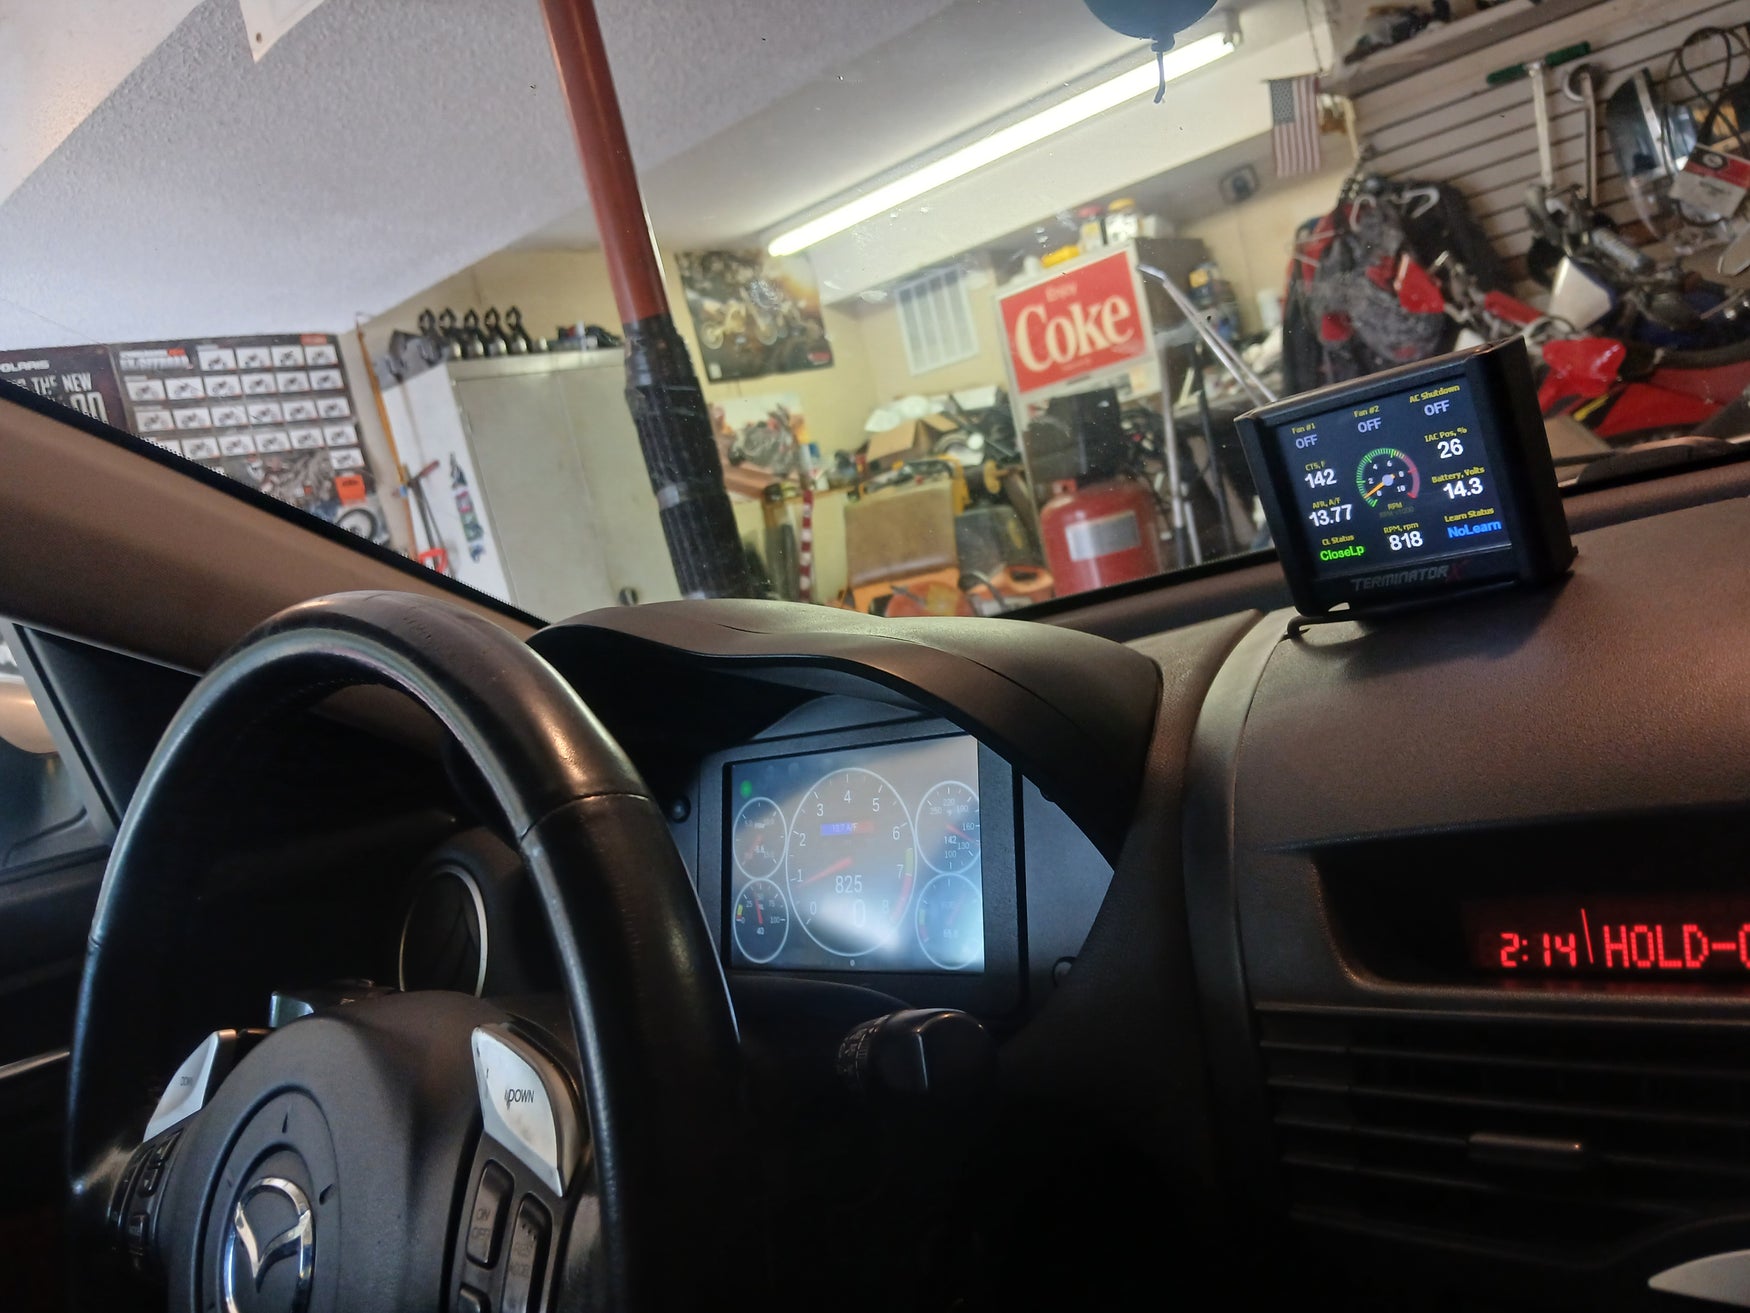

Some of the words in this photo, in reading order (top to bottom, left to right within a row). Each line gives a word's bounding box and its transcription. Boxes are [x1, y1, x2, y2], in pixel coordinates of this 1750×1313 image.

[1015, 295, 1134, 372] Coke
[0, 360, 50, 373] OLARIS
[62, 372, 92, 393] NEW
[1409, 394, 1420, 403] AC
[1421, 385, 1460, 400] Shutdown
[1353, 409, 1367, 418] Fan
[1368, 405, 1380, 414] #2
[1424, 400, 1450, 416] OFF
[1291, 426, 1305, 434] Fan
[1305, 423, 1316, 431] #1
[1357, 417, 1381, 433] OFF
[1295, 434, 1318, 449] OFF
[1424, 433, 1439, 442] IAC
[1437, 438, 1464, 459] 26
[1304, 468, 1337, 488] 142
[1431, 472, 1464, 483] Battery,
[1464, 466, 1485, 476] Volts
[1443, 477, 1484, 499] 14.3
[1387, 502, 1403, 510] RPM
[1309, 503, 1352, 527] 13.77
[1444, 513, 1467, 522] Learn
[1467, 507, 1494, 518] Status
[1383, 525, 1403, 534] RPM,
[1403, 522, 1419, 531] rpm
[1447, 520, 1502, 538] NoLearn
[1322, 538, 1331, 546] CL
[1331, 535, 1354, 545] Status
[1388, 531, 1423, 551] 818
[1320, 545, 1365, 561] CloseLp
[1351, 564, 1450, 591] TERMINATOR
[844, 790, 852, 804] 4
[816, 803, 824, 817] 3
[872, 798, 880, 812] 5
[892, 826, 900, 840] 6
[963, 823, 975, 831] 160
[799, 833, 807, 846] 2
[797, 869, 803, 882] 1
[896, 864, 904, 879] 7
[835, 875, 862, 893] 825
[809, 901, 817, 915] 0
[853, 899, 866, 928] 0
[1501, 932, 1577, 967] 2:14
[508, 1088, 535, 1103] DOWN
